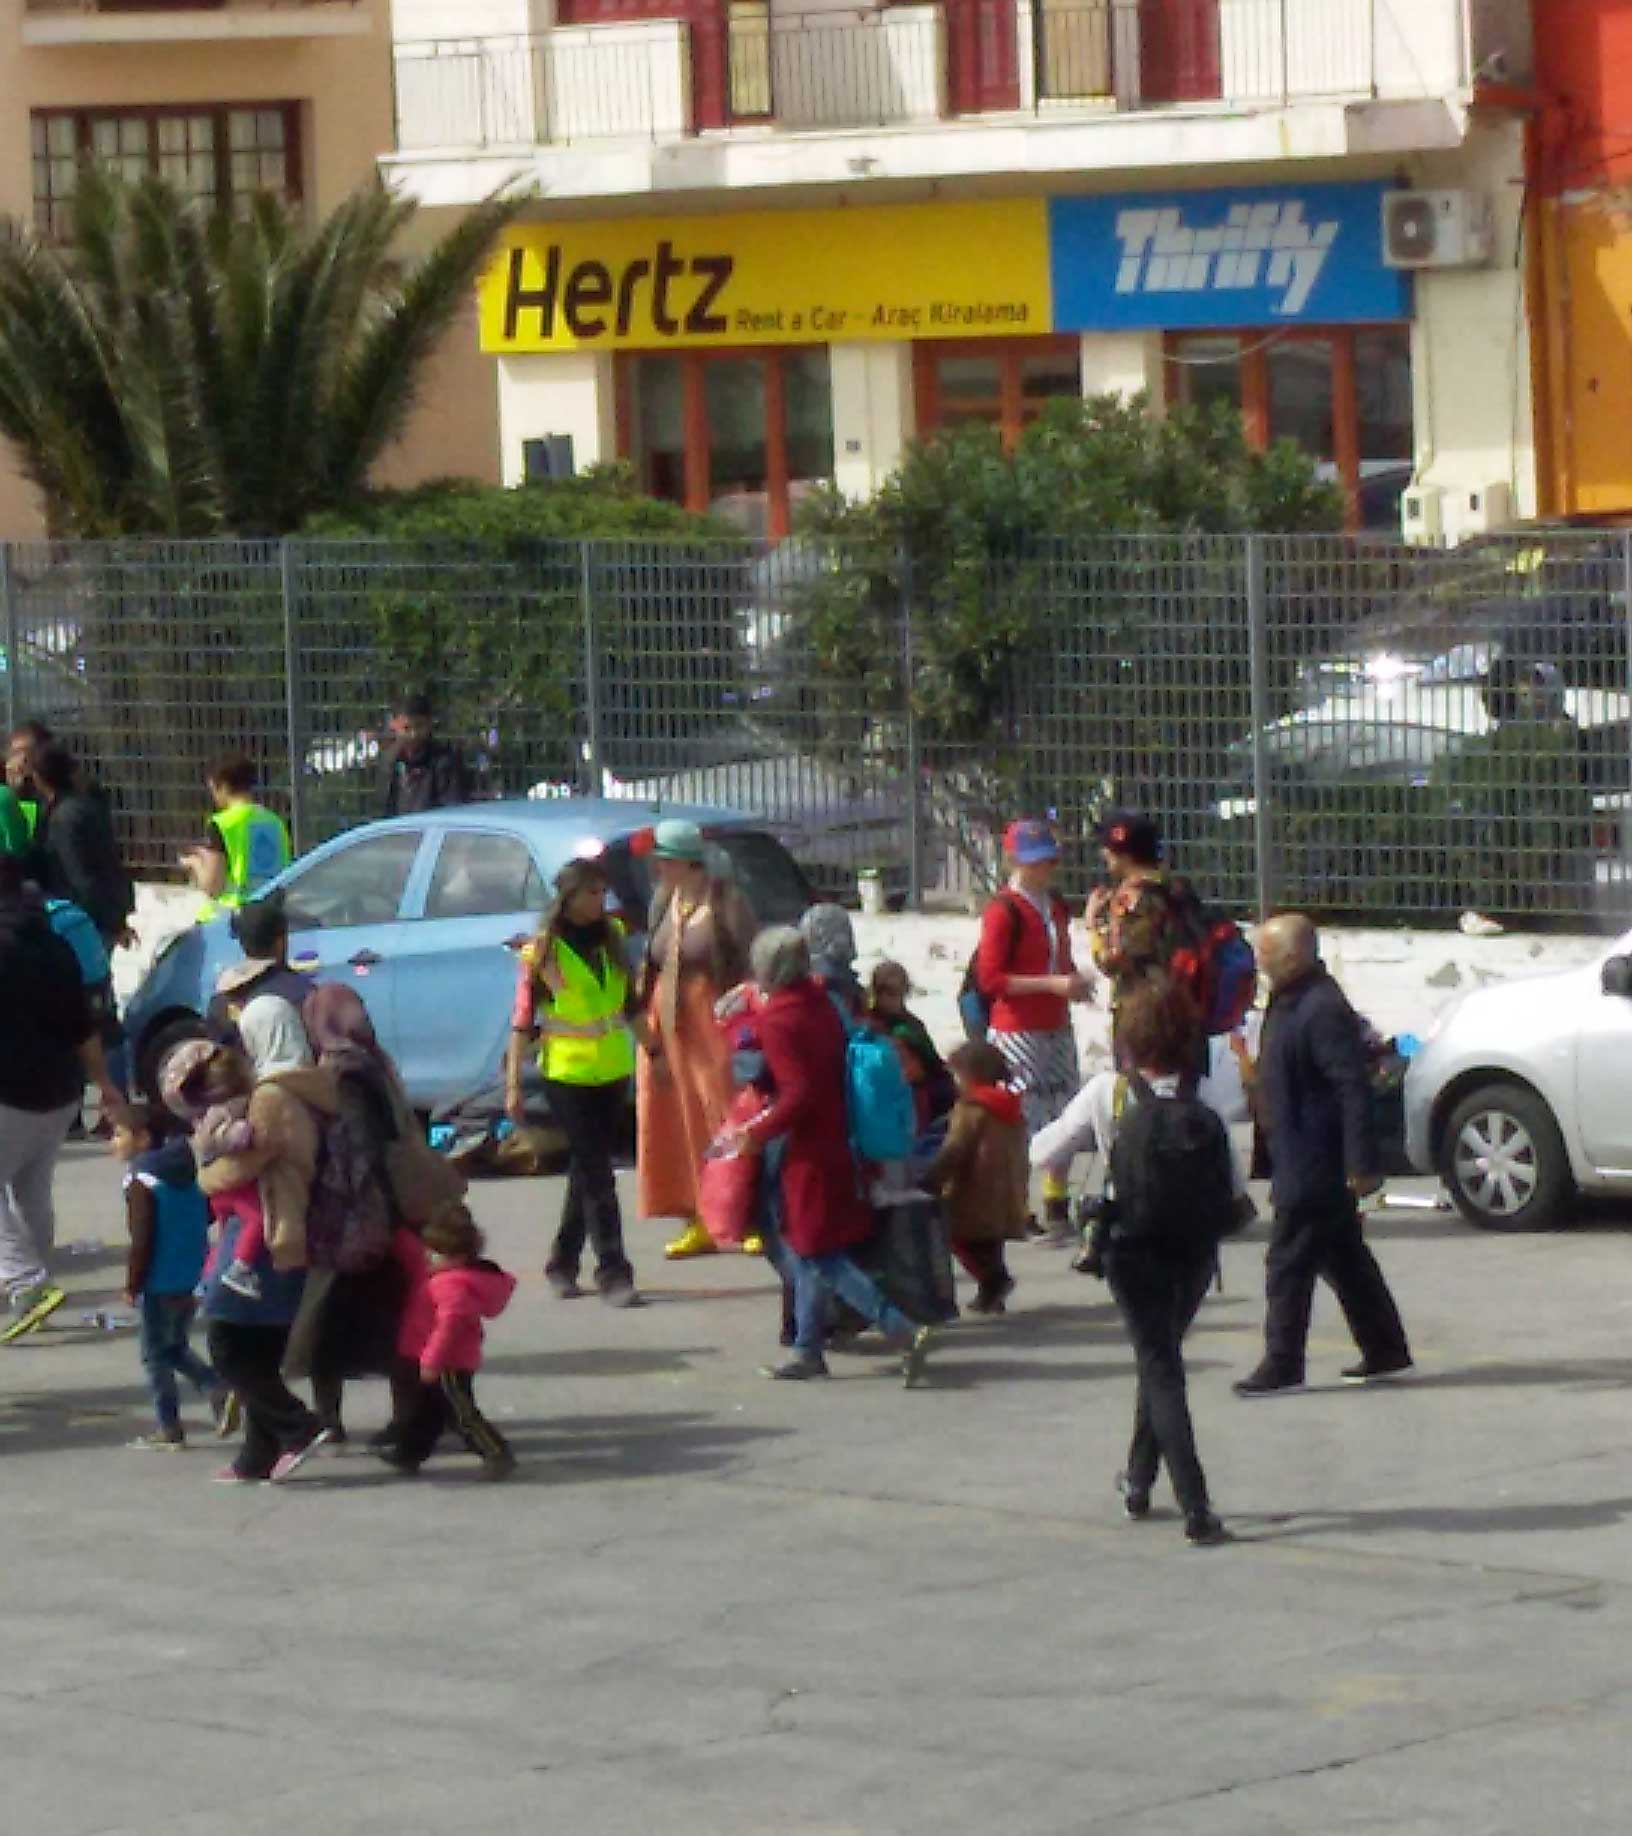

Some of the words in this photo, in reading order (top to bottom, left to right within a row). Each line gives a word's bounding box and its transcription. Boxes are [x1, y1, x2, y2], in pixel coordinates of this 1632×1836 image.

[504, 240, 734, 339] Hertz
[1115, 201, 1340, 314] Thrifty
[736, 306, 784, 331] Rent
[791, 312, 802, 331] a
[809, 304, 847, 330] Car
